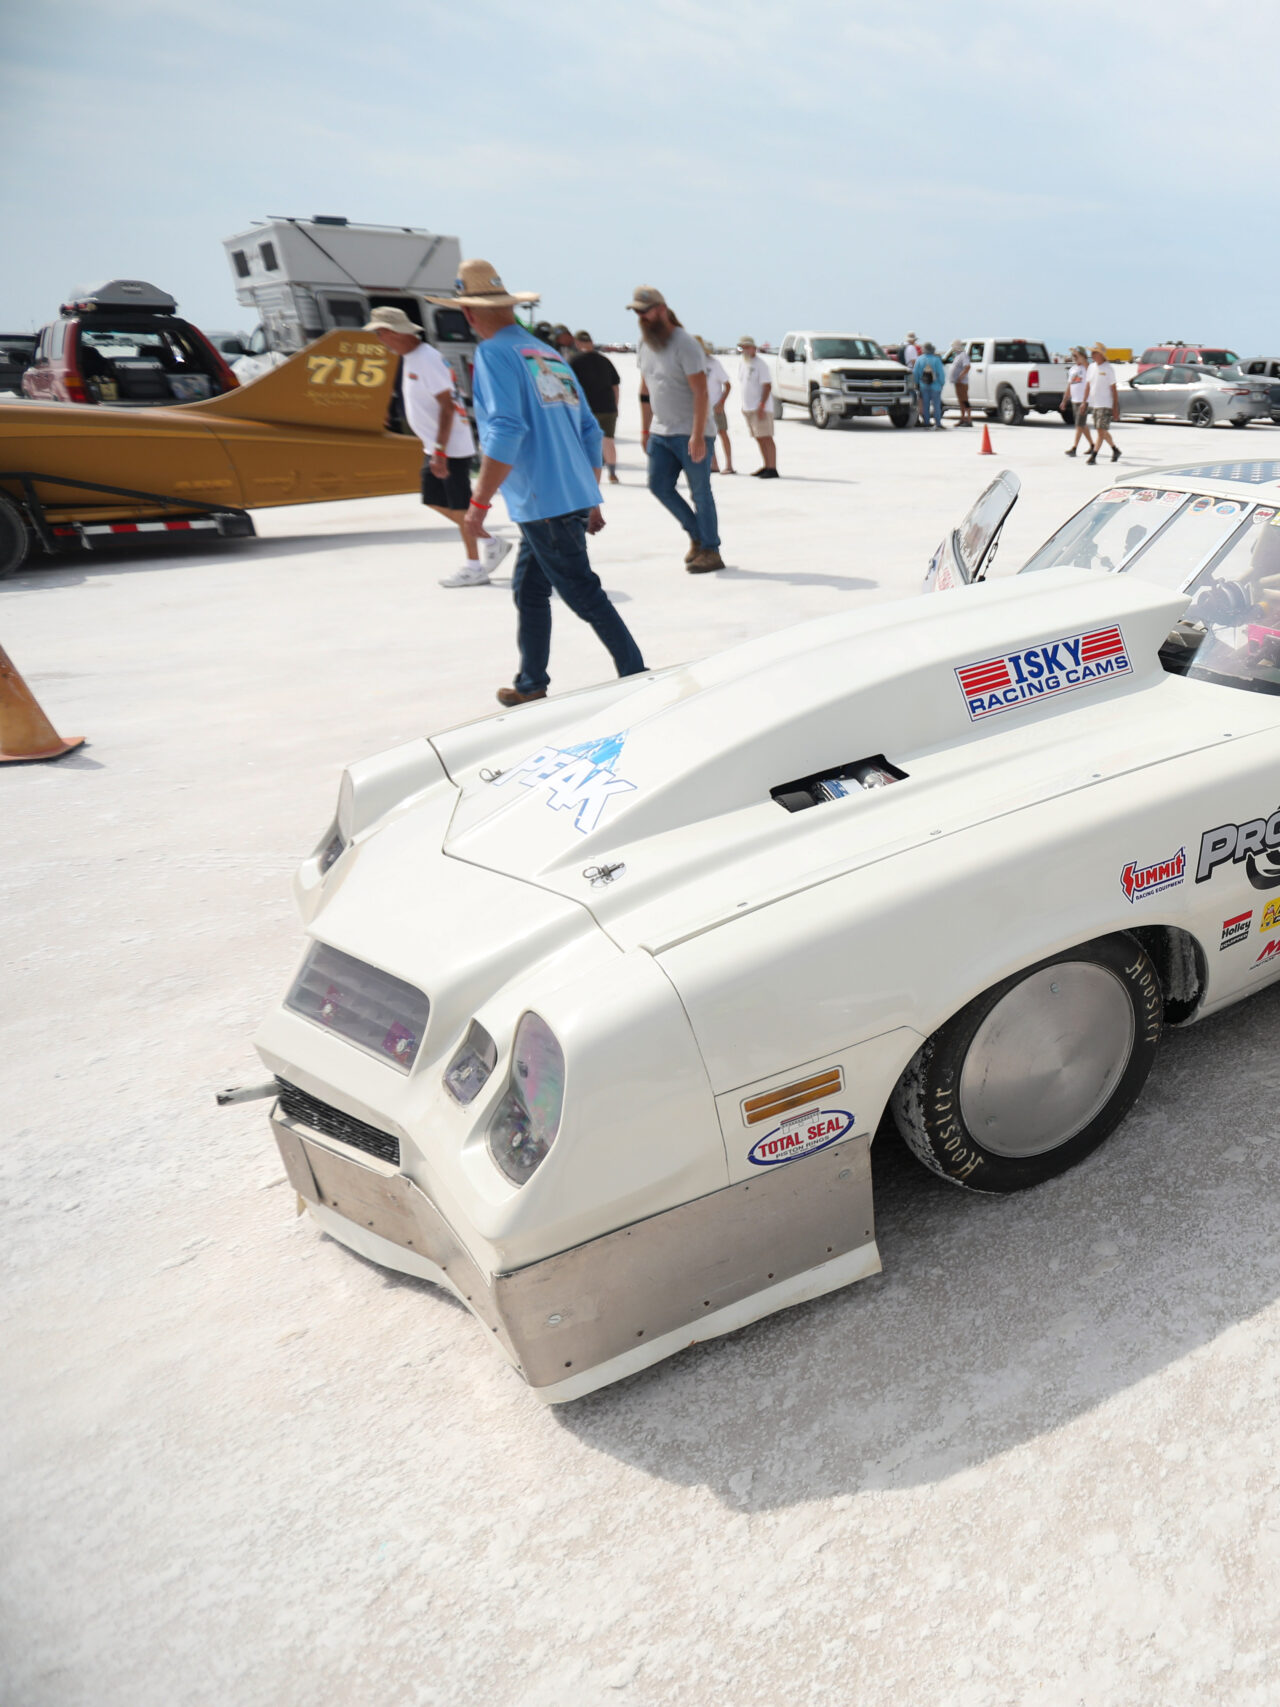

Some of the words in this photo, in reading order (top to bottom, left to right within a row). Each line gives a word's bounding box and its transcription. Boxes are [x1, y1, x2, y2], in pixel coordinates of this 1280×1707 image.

[307, 355, 389, 387] 715
[1007, 638, 1082, 684] ISKY
[968, 675, 1061, 714] RACING
[1065, 655, 1129, 684] CAMS
[492, 745, 638, 834] PEAK
[1122, 852, 1184, 899] SUMMIT
[1135, 888, 1155, 900] RACING
[1155, 878, 1185, 894] EQUIPMENT
[1221, 919, 1251, 940] Holley
[758, 1132, 804, 1158] TOTAL
[807, 1117, 844, 1141] SEAL
[775, 1144, 804, 1159] PISTON
[806, 1135, 830, 1148] RINGS
